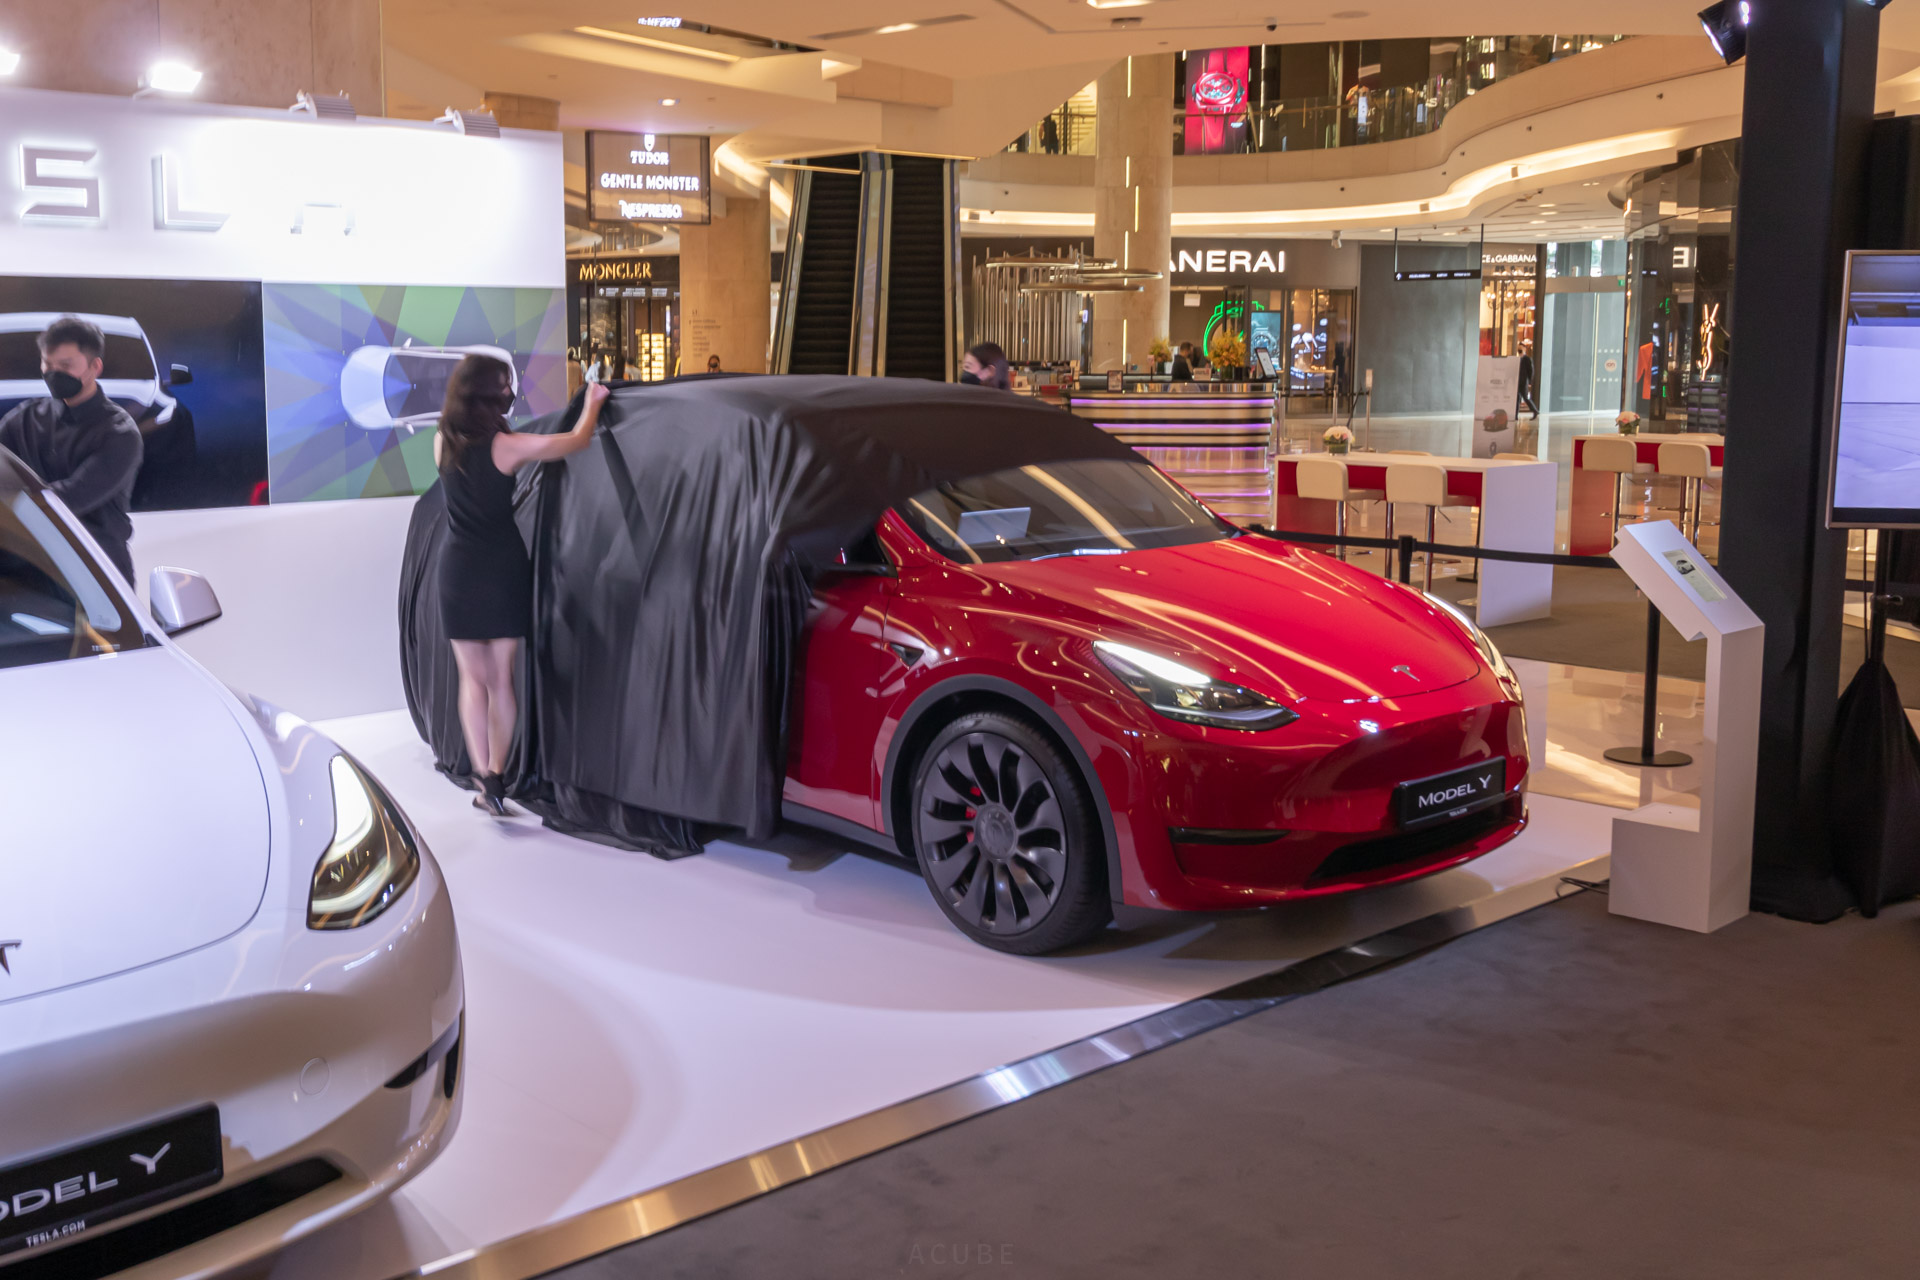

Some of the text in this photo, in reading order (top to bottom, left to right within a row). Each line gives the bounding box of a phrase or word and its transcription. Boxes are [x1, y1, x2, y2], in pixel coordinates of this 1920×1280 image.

[630, 151, 669, 165] TUDOR
[601, 173, 699, 191] GENTLE MONSTER
[579, 262, 652, 281] MONCLER
[1418, 773, 1492, 808] MODEL Y
[0, 1142, 171, 1221] DEL Y
